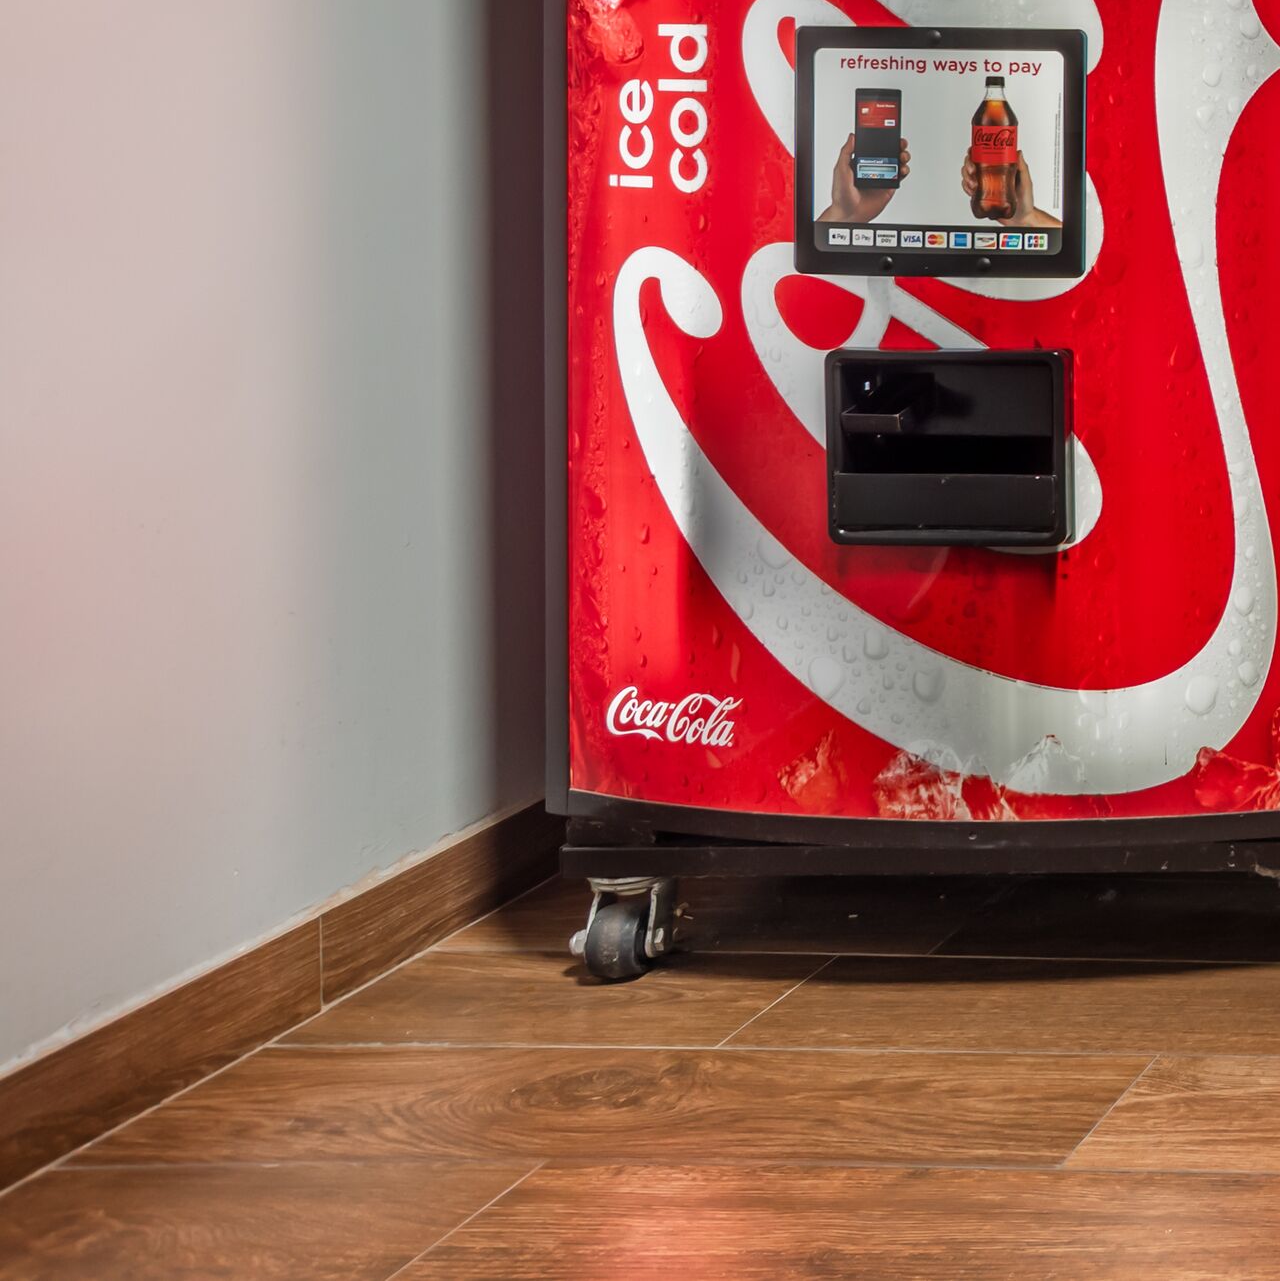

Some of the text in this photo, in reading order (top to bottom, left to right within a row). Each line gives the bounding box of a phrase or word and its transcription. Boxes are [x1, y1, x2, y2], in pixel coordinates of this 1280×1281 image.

[840, 54, 1042, 76] refreshing ways to pay
[658, 23, 709, 194] cold
[609, 79, 654, 189] ice
[974, 127, 1016, 147] Coca-Cola
[903, 234, 922, 244] VISA
[606, 686, 744, 748] Coca-Cola
